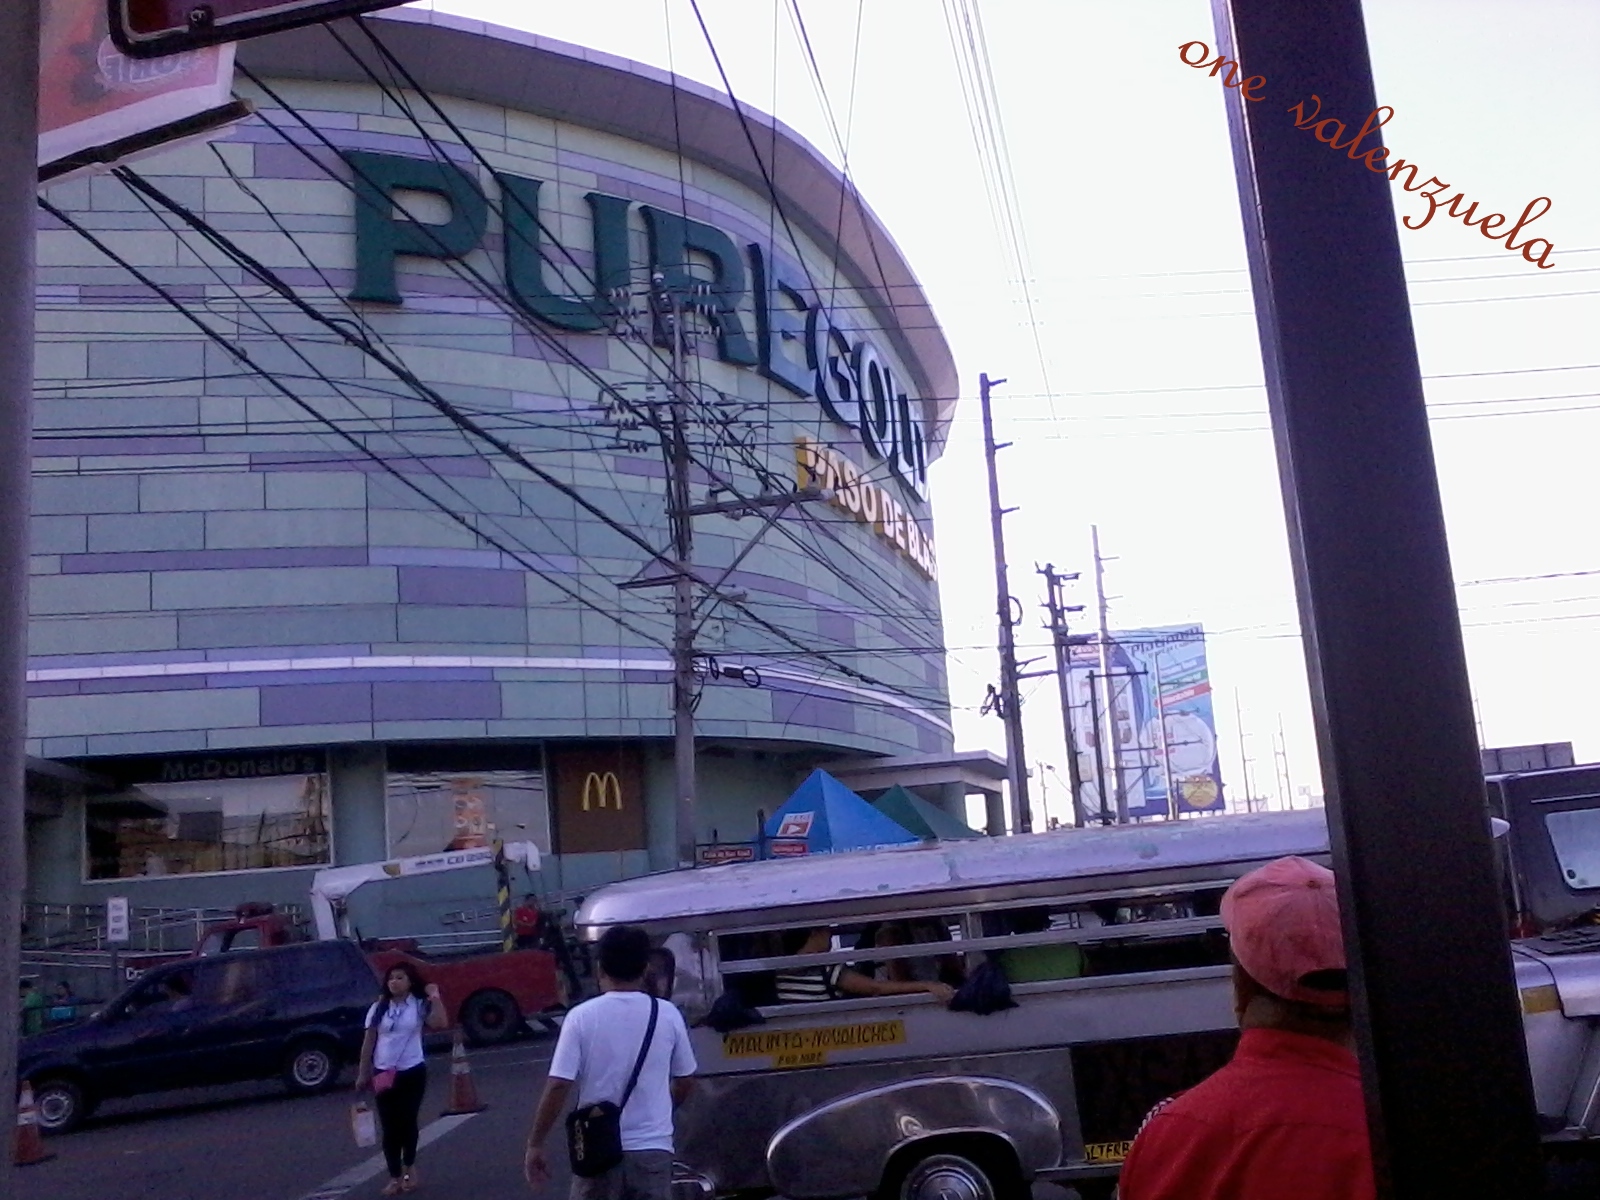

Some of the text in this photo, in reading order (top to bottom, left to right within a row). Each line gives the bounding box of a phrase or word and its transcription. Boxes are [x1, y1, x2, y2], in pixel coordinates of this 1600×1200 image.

[345, 150, 929, 503] PUREGOLD
[875, 488, 906, 550] DE
[162, 753, 315, 780] McDonald's
